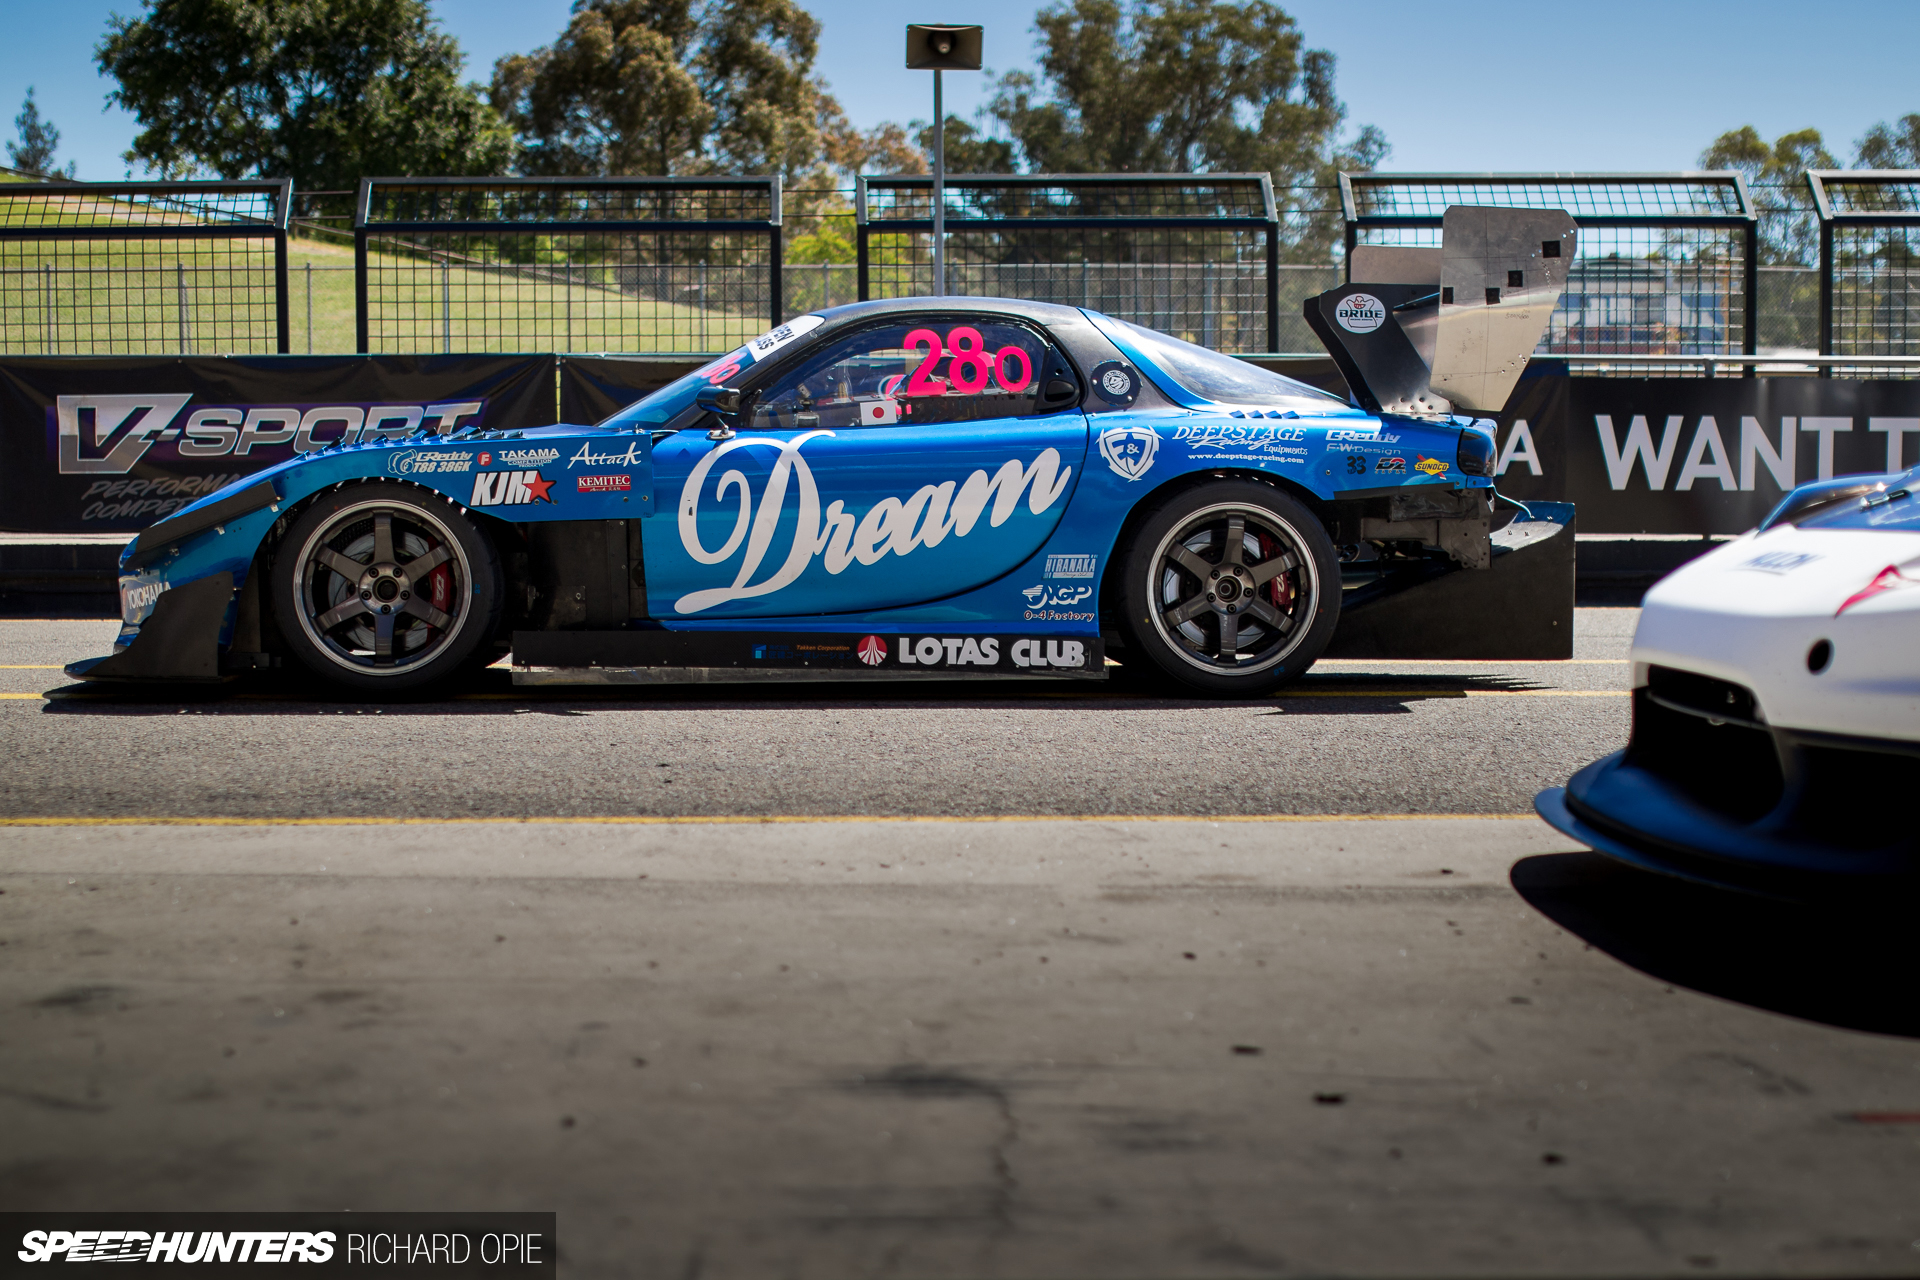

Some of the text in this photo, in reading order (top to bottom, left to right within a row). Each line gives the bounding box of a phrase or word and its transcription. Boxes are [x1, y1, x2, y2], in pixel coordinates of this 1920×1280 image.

[1339, 310, 1383, 318] BRIDE
[903, 326, 1032, 397] 280
[57, 394, 482, 474] V-SPORT
[1172, 425, 1307, 441] DEEPSTAGE
[1186, 437, 1280, 450] Racing
[1263, 444, 1308, 455] Equipments
[498, 448, 560, 459] TAKAMA
[567, 441, 642, 470] Attack
[1188, 453, 1305, 464] www.deepstage-racing.com
[1595, 414, 1853, 491] WANT
[413, 462, 435, 473] T88
[1375, 457, 1406, 470] D2
[1416, 462, 1448, 471] SUNOCO
[578, 475, 631, 487] KEMITEC
[470, 472, 538, 506] KJM
[81, 496, 202, 521] COMPET
[674, 430, 1072, 614] Dream
[1044, 558, 1096, 572] HIRANAKA
[899, 637, 1085, 667] LOTAS CLUB
